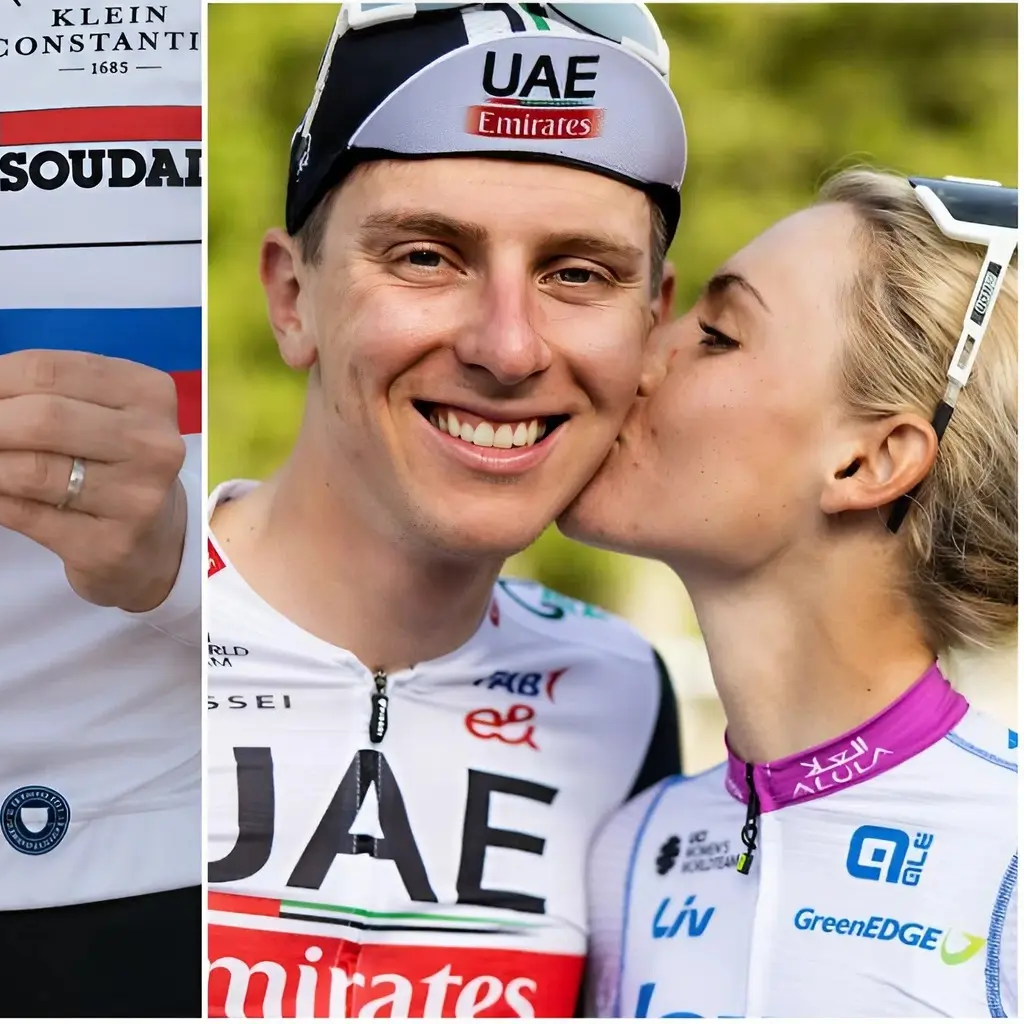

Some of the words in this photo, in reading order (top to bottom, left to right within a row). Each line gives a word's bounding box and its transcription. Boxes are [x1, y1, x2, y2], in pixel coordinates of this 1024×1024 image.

[52, 5, 167, 27] KLEIN
[91, 61, 128, 75] 1685
[483, 51, 600, 99] UAE
[478, 111, 592, 136] Emirates
[792, 747, 894, 799] ALULA
[652, 895, 715, 939] Liv
[794, 908, 943, 951] GreenEDGE
